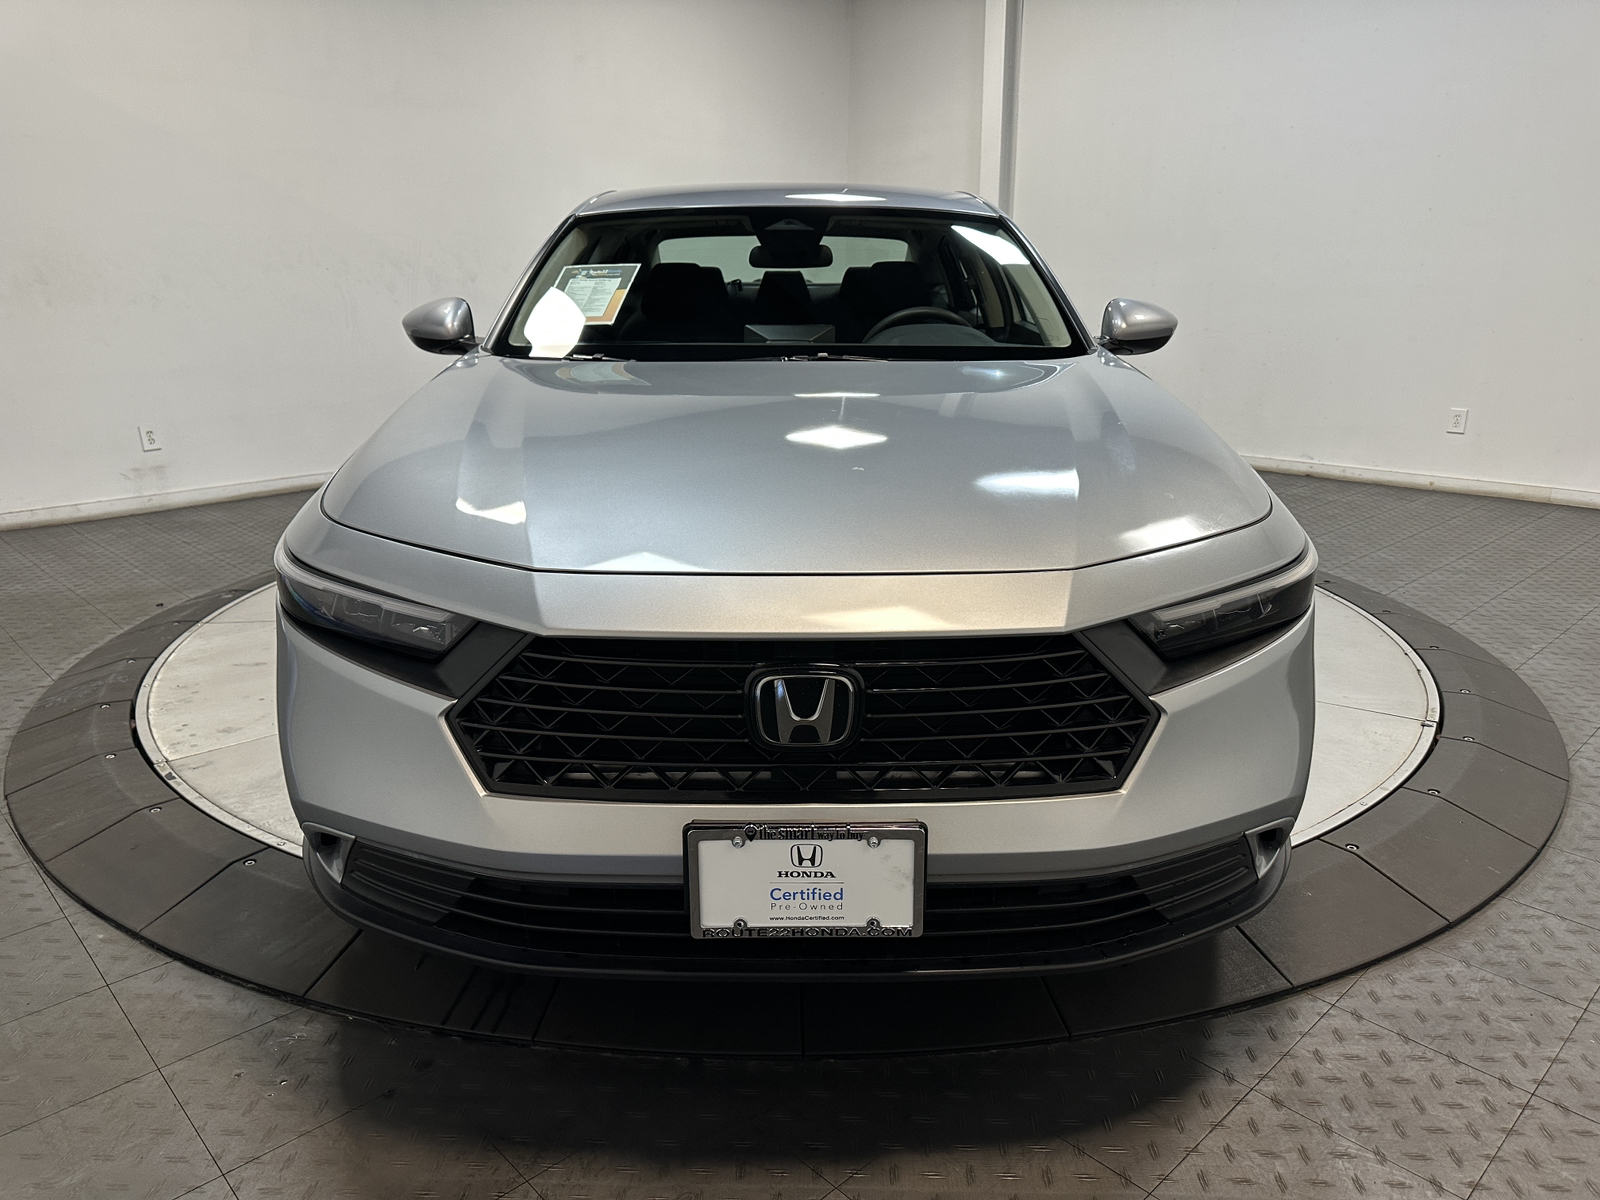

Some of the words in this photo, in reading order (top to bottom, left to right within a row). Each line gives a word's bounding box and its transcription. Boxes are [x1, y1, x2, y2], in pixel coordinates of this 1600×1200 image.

[759, 824, 776, 840] the
[778, 823, 816, 840] smart
[817, 829, 835, 842] way
[836, 827, 846, 840] to
[847, 824, 864, 842] buy
[777, 870, 837, 879] HONDA
[769, 887, 844, 901] Certified
[770, 902, 844, 911] Pre-Owned
[702, 927, 913, 938] ROUTE22HONDA.COM
